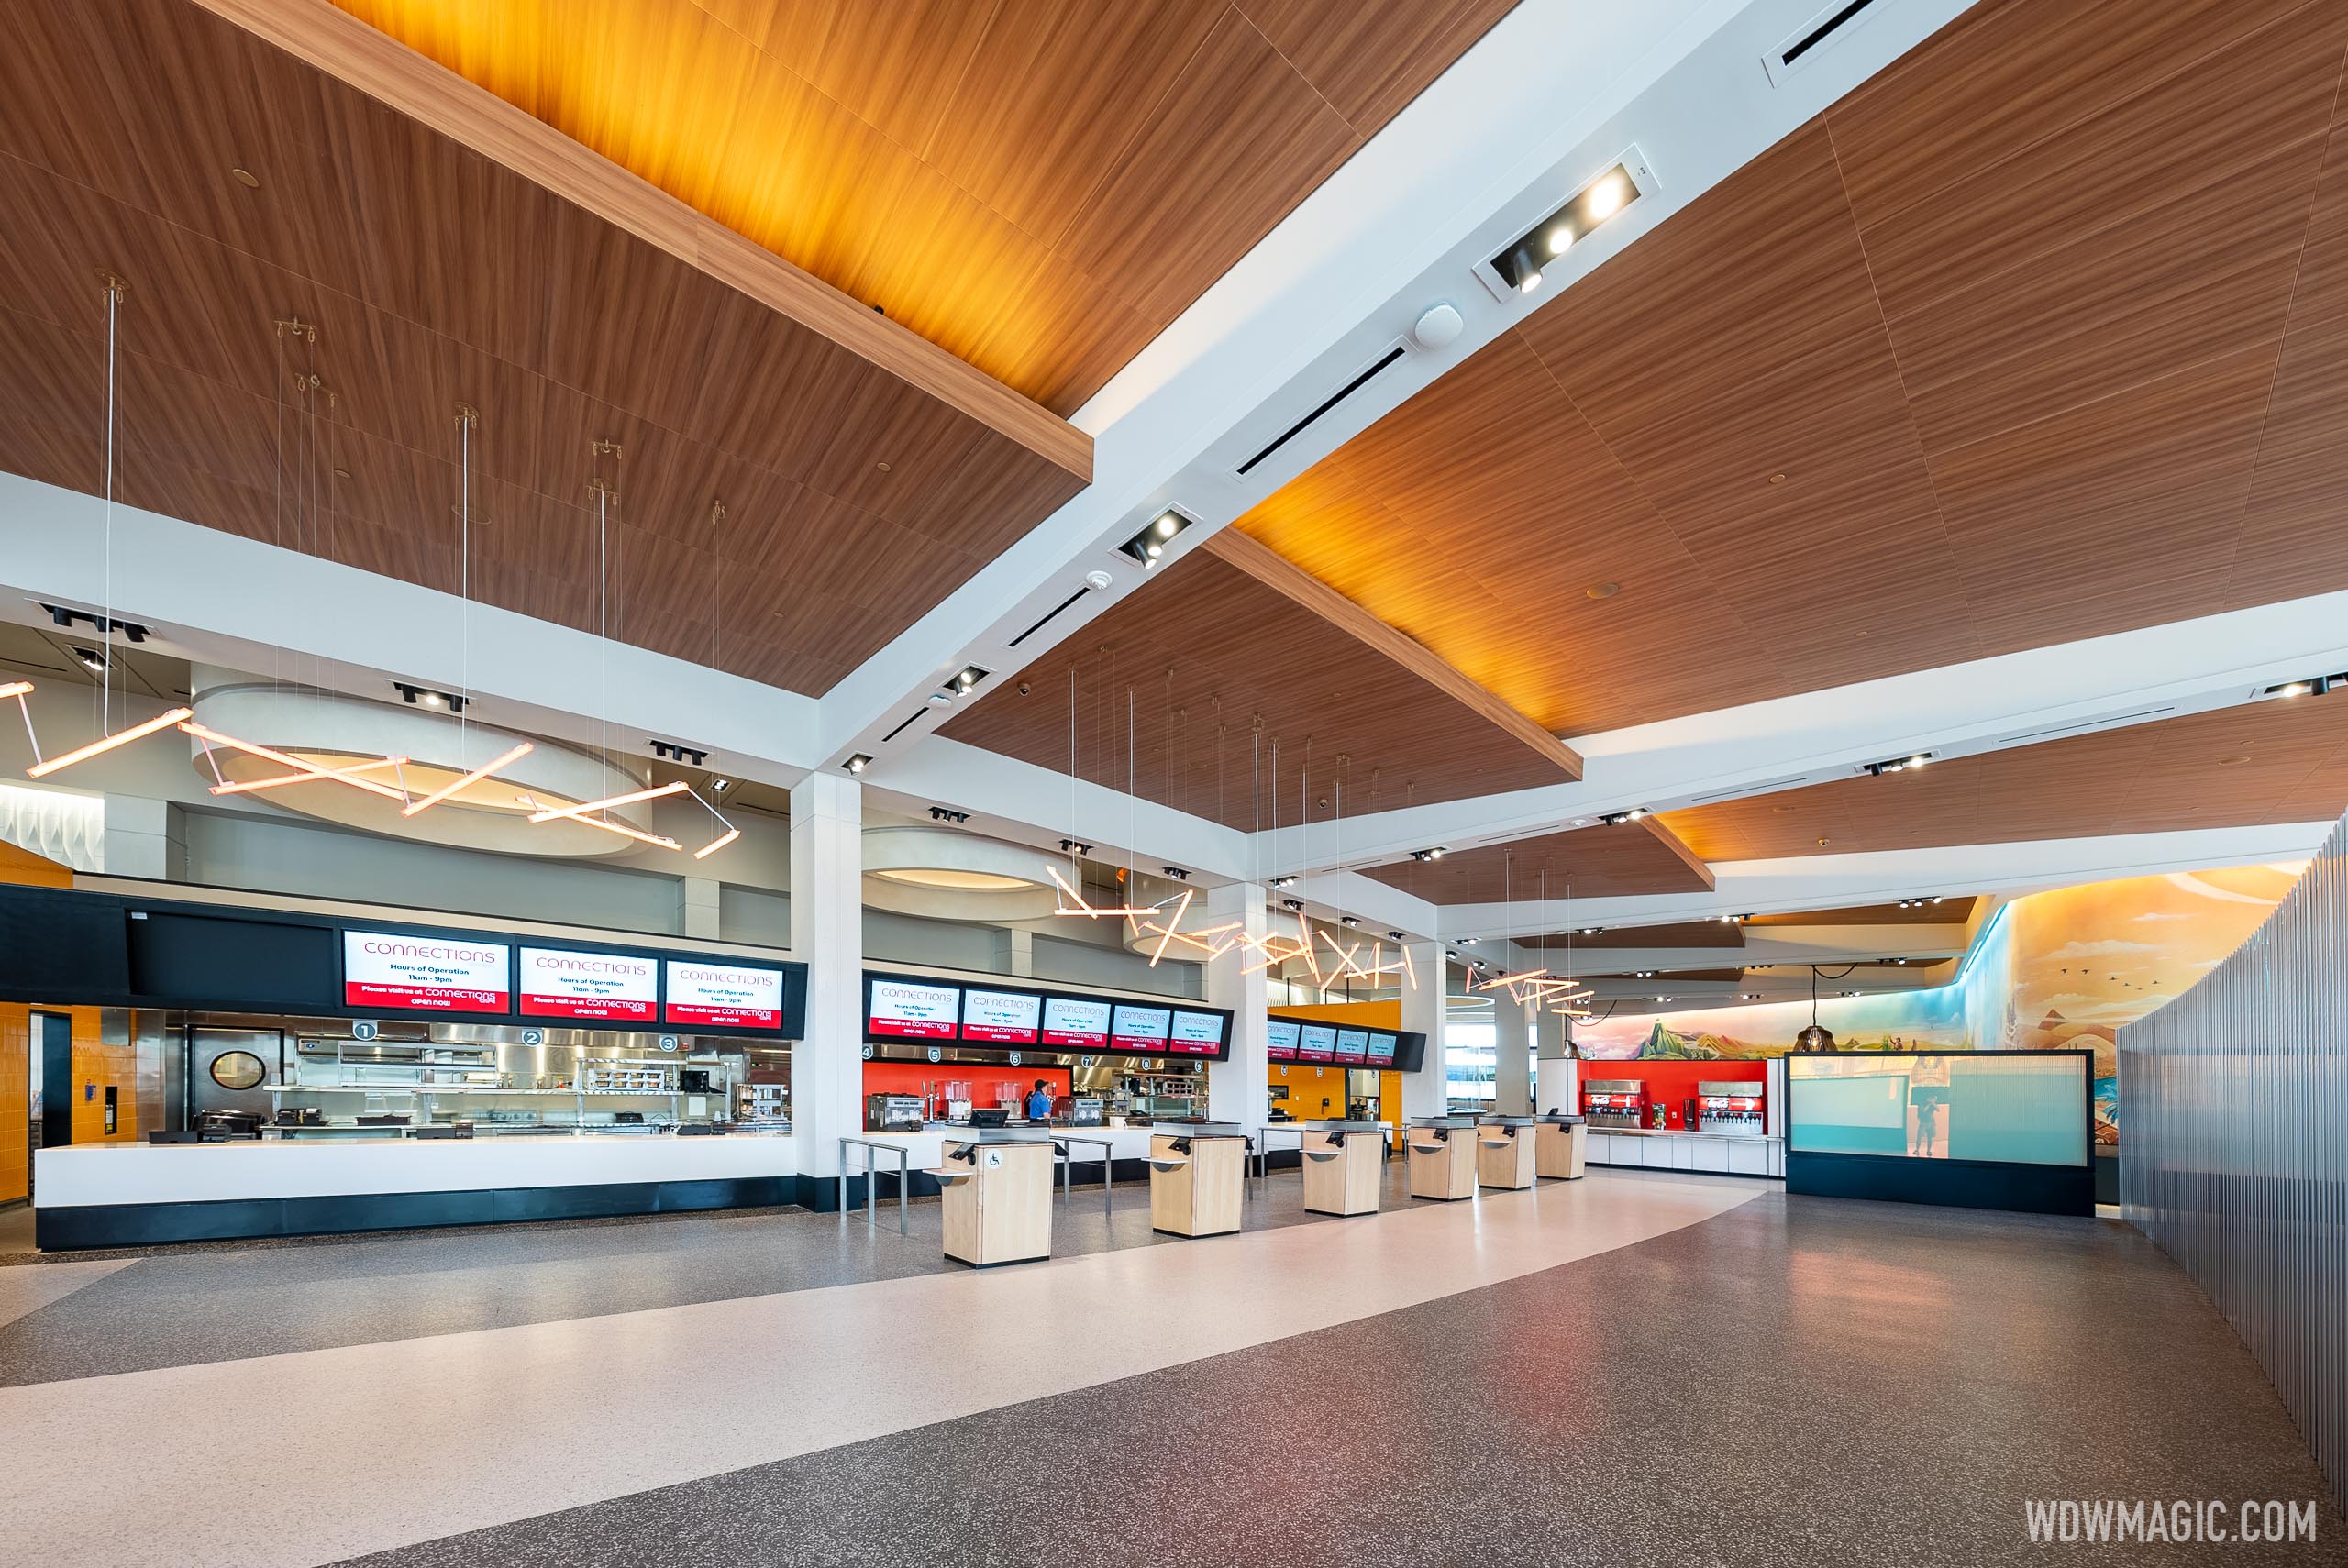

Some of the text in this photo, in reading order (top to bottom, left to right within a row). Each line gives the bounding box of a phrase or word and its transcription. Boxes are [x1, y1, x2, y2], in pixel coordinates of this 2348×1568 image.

[364, 942, 495, 963] CONNECTIONS
[390, 964, 415, 972] Hours
[428, 966, 469, 976] Operation
[537, 957, 646, 976] CONNECTIONS
[681, 970, 773, 987] CONNECTIONS
[425, 988, 495, 999] CONNECTIONS
[882, 988, 951, 1002] CONNECTIONS
[360, 1026, 368, 1037] 1
[526, 1032, 537, 1043] 2
[665, 1039, 673, 1048] 3
[862, 1048, 869, 1057] 4
[931, 1051, 937, 1059] 5
